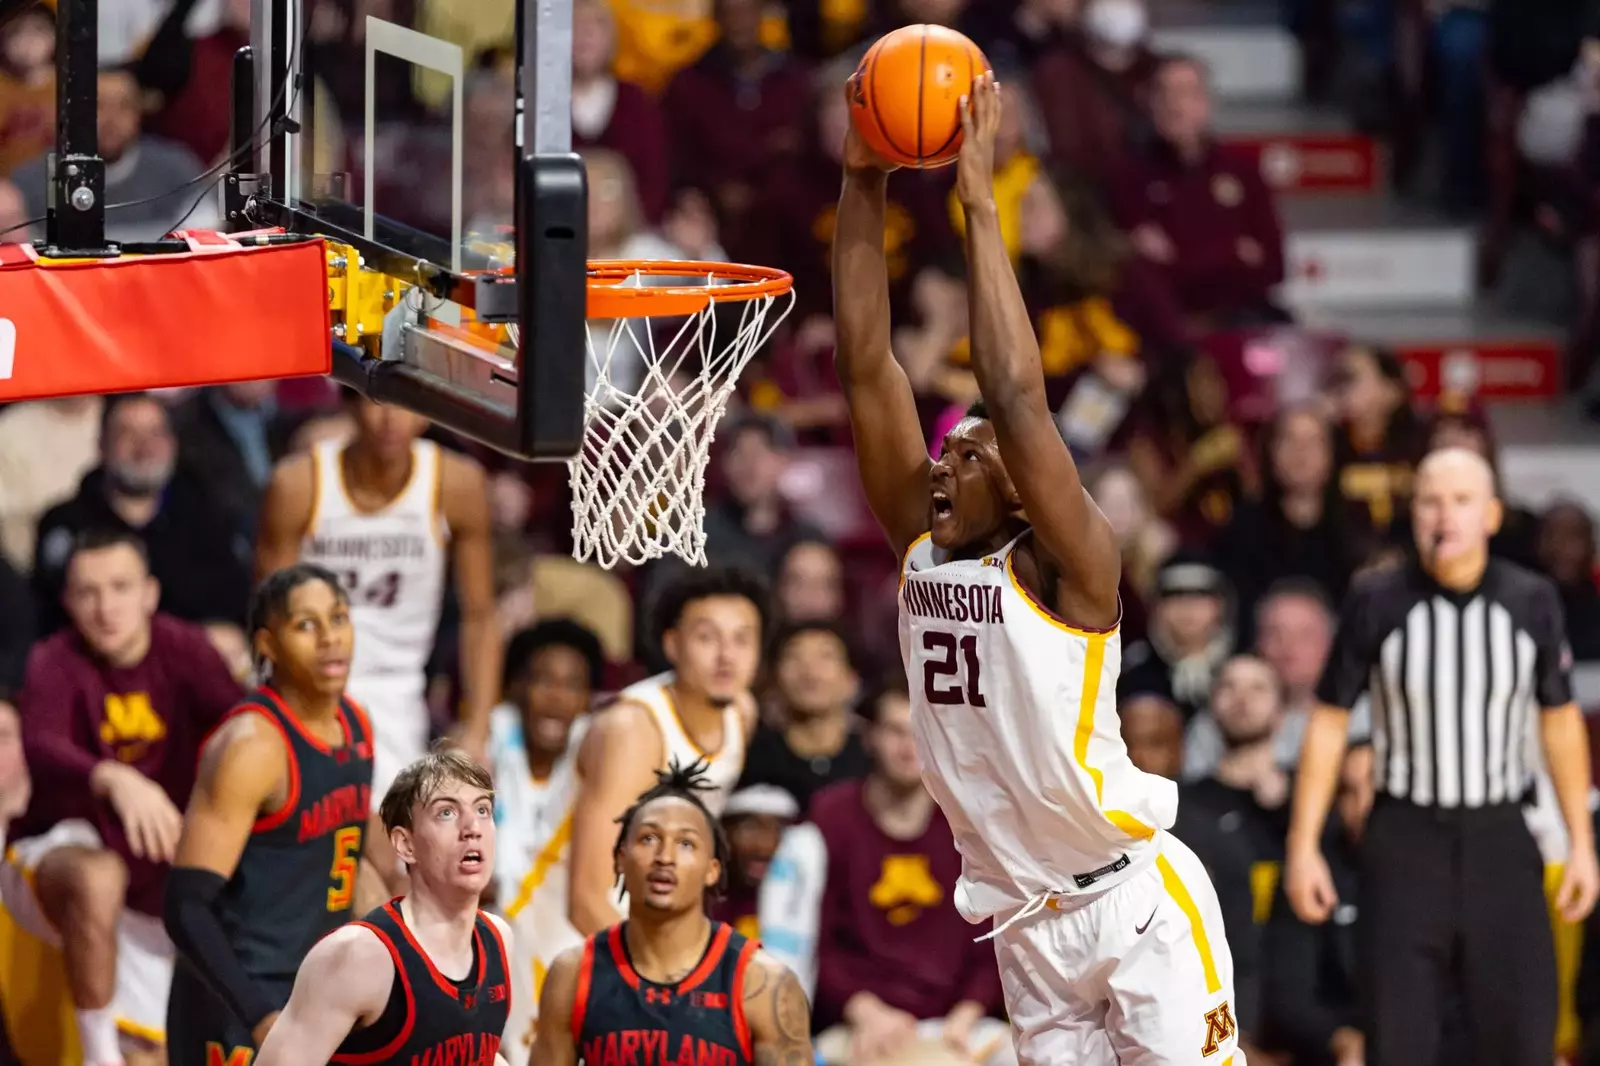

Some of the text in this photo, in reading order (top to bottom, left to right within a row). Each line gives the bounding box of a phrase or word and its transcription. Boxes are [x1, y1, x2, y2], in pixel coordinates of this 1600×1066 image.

[903, 578, 1005, 624] MINNESOTA
[922, 630, 987, 708] 21
[326, 826, 362, 912] 5
[583, 1029, 737, 1066] MARYLAND
[1201, 1000, 1236, 1058] M
